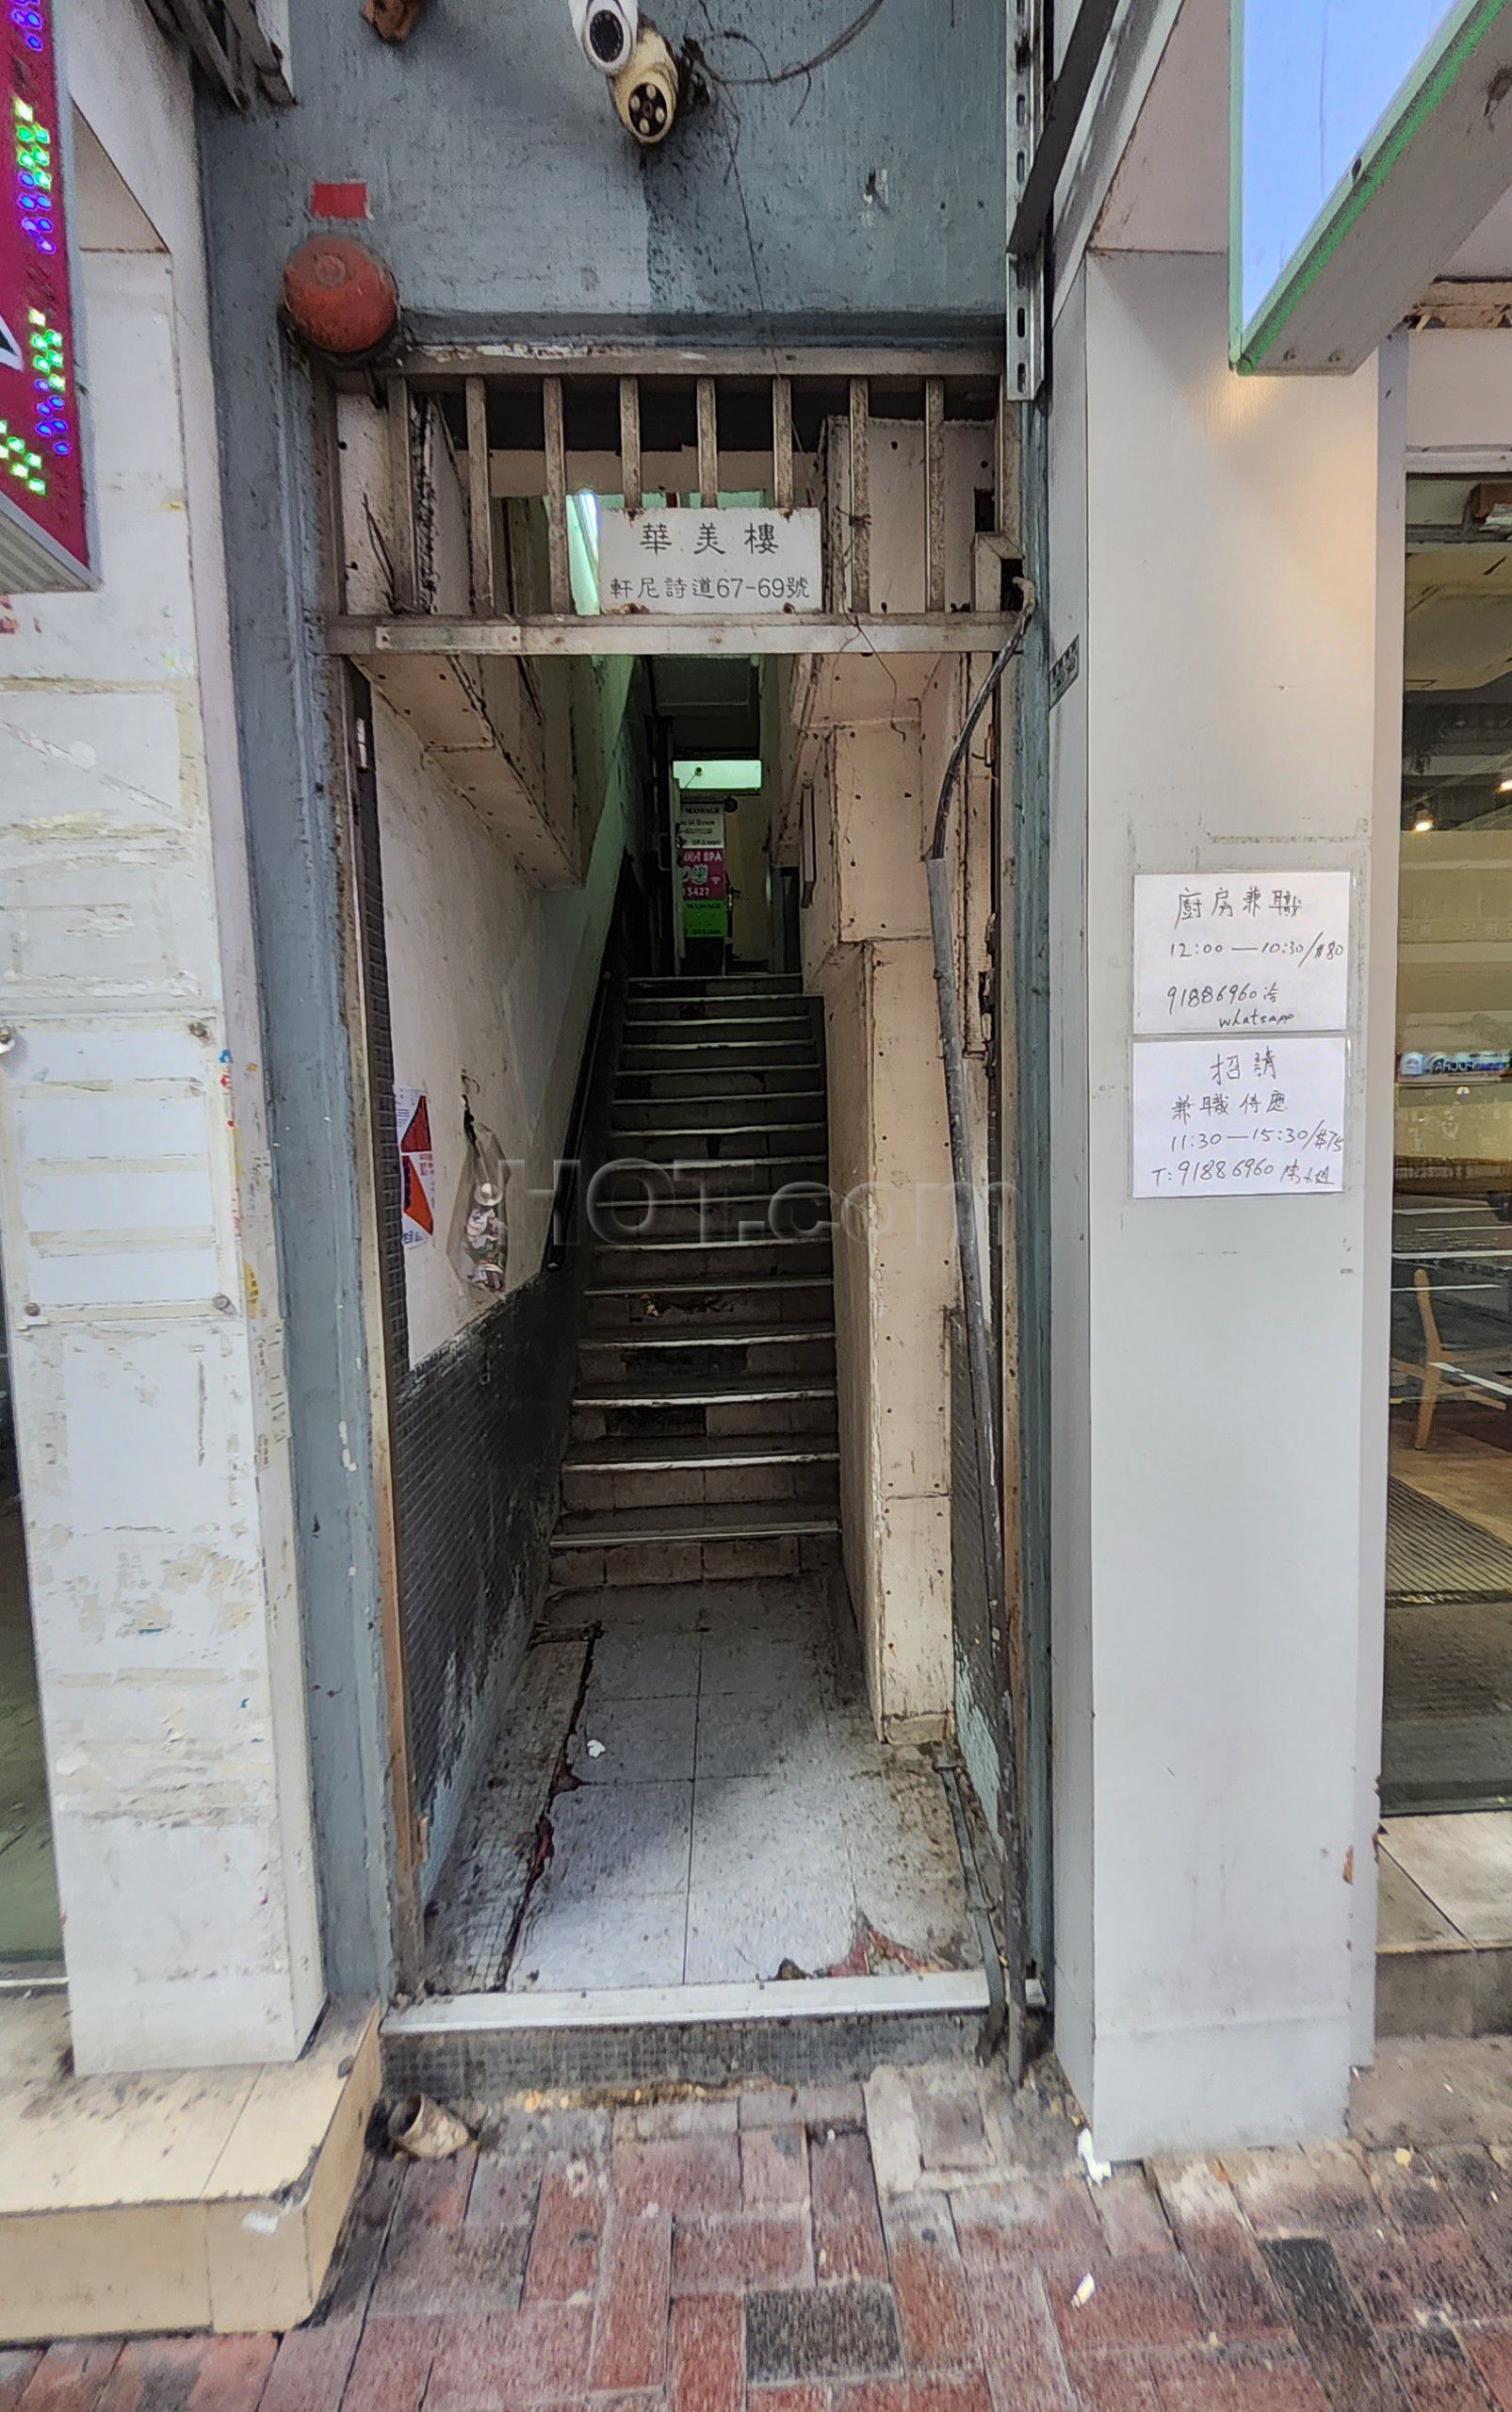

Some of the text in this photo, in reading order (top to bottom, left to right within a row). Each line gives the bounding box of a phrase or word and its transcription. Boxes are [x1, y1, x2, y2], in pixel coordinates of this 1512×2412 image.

[640, 522, 779, 555] 華美樓
[610, 577, 810, 599] 軒尼詩道67-69號
[703, 851, 723, 862] SPA
[1210, 1045, 1278, 1085] 招請
